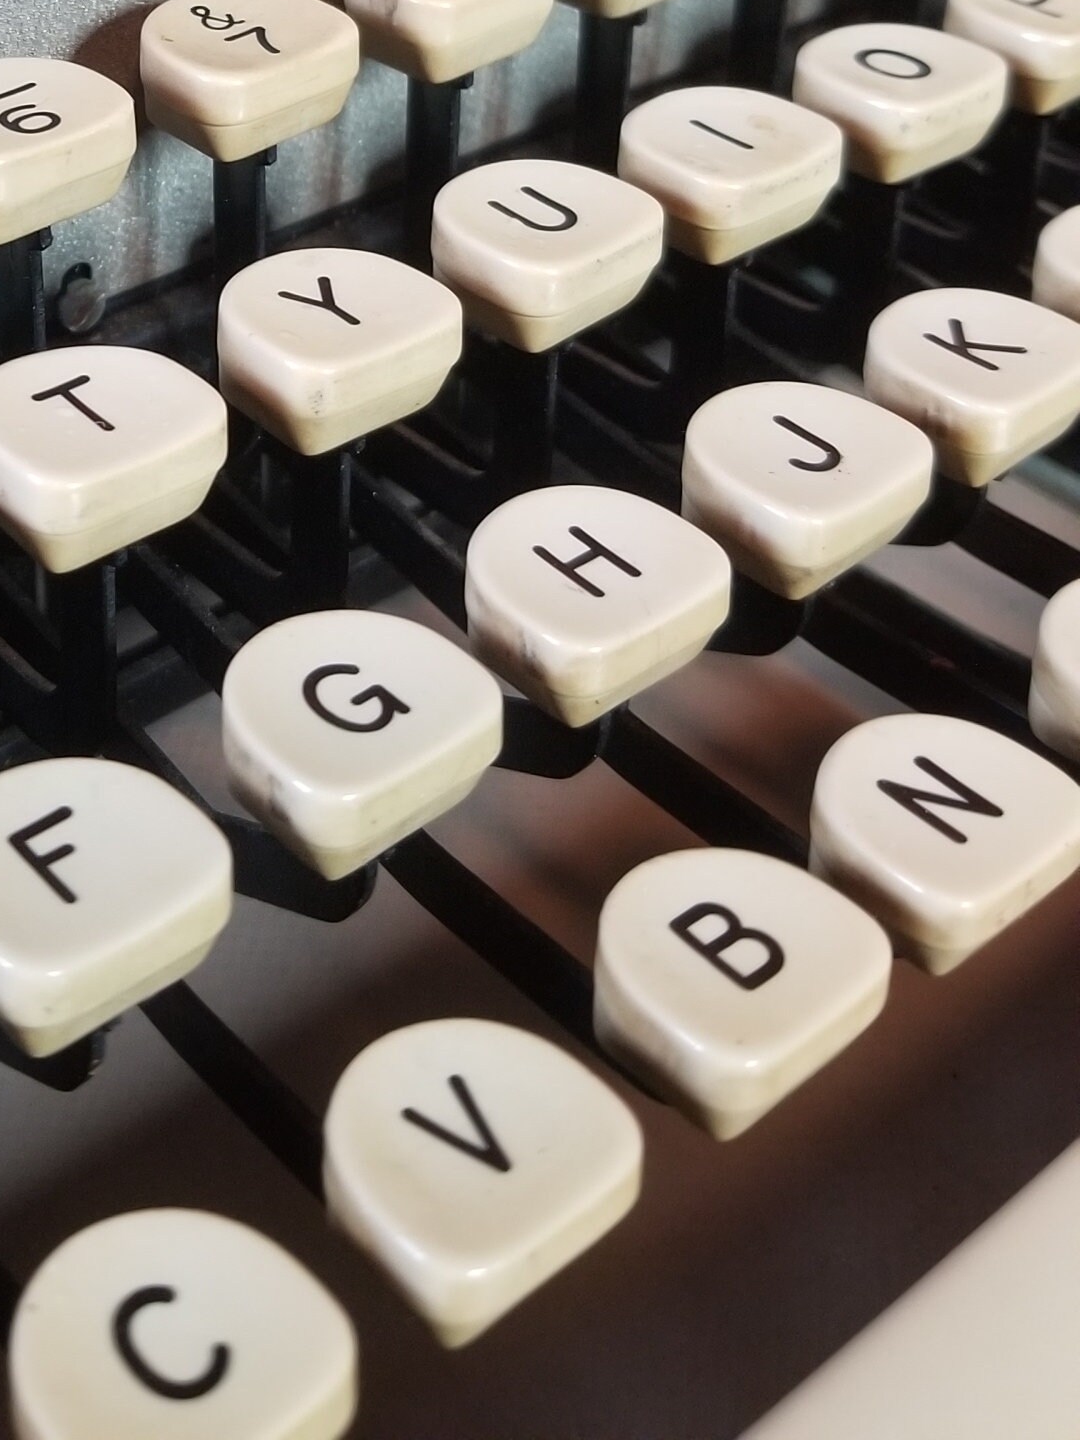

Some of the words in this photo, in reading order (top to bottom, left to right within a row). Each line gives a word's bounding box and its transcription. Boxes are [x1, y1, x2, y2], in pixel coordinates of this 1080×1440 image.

[224, 26, 280, 54] 7
[854, 48, 932, 80] O
[487, 186, 578, 232] U
[277, 276, 361, 326] Y
[923, 318, 1028, 371] K
[31, 374, 116, 432] T
[773, 415, 843, 473] J
[532, 525, 643, 598] H
[301, 663, 411, 734] G
[876, 755, 1005, 845] N
[7, 805, 78, 905] F
[668, 902, 786, 992] B
[401, 1074, 513, 1174] V
[110, 1284, 232, 1403] C
